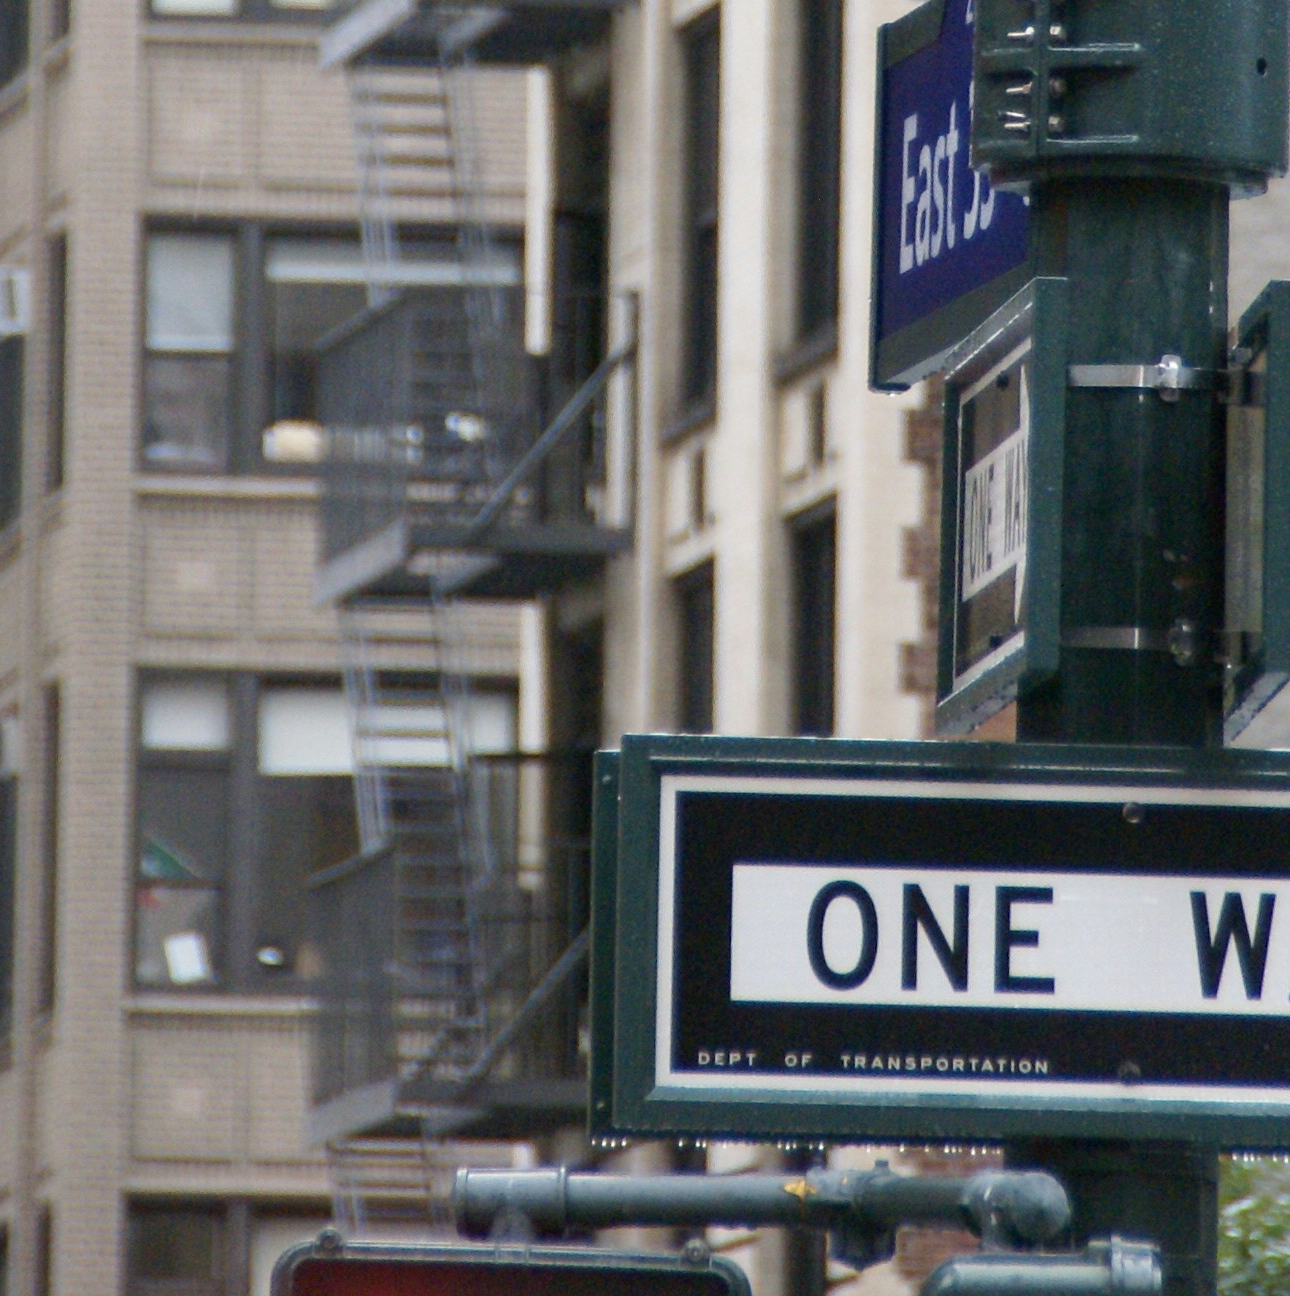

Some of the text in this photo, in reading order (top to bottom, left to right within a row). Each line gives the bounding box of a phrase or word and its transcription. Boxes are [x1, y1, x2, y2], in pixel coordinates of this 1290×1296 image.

[899, 99, 959, 275] East
[969, 461, 995, 585] ONE
[806, 878, 1057, 995] ONE
[697, 1051, 1050, 1075] DEPT OF TRANSPORTATION
